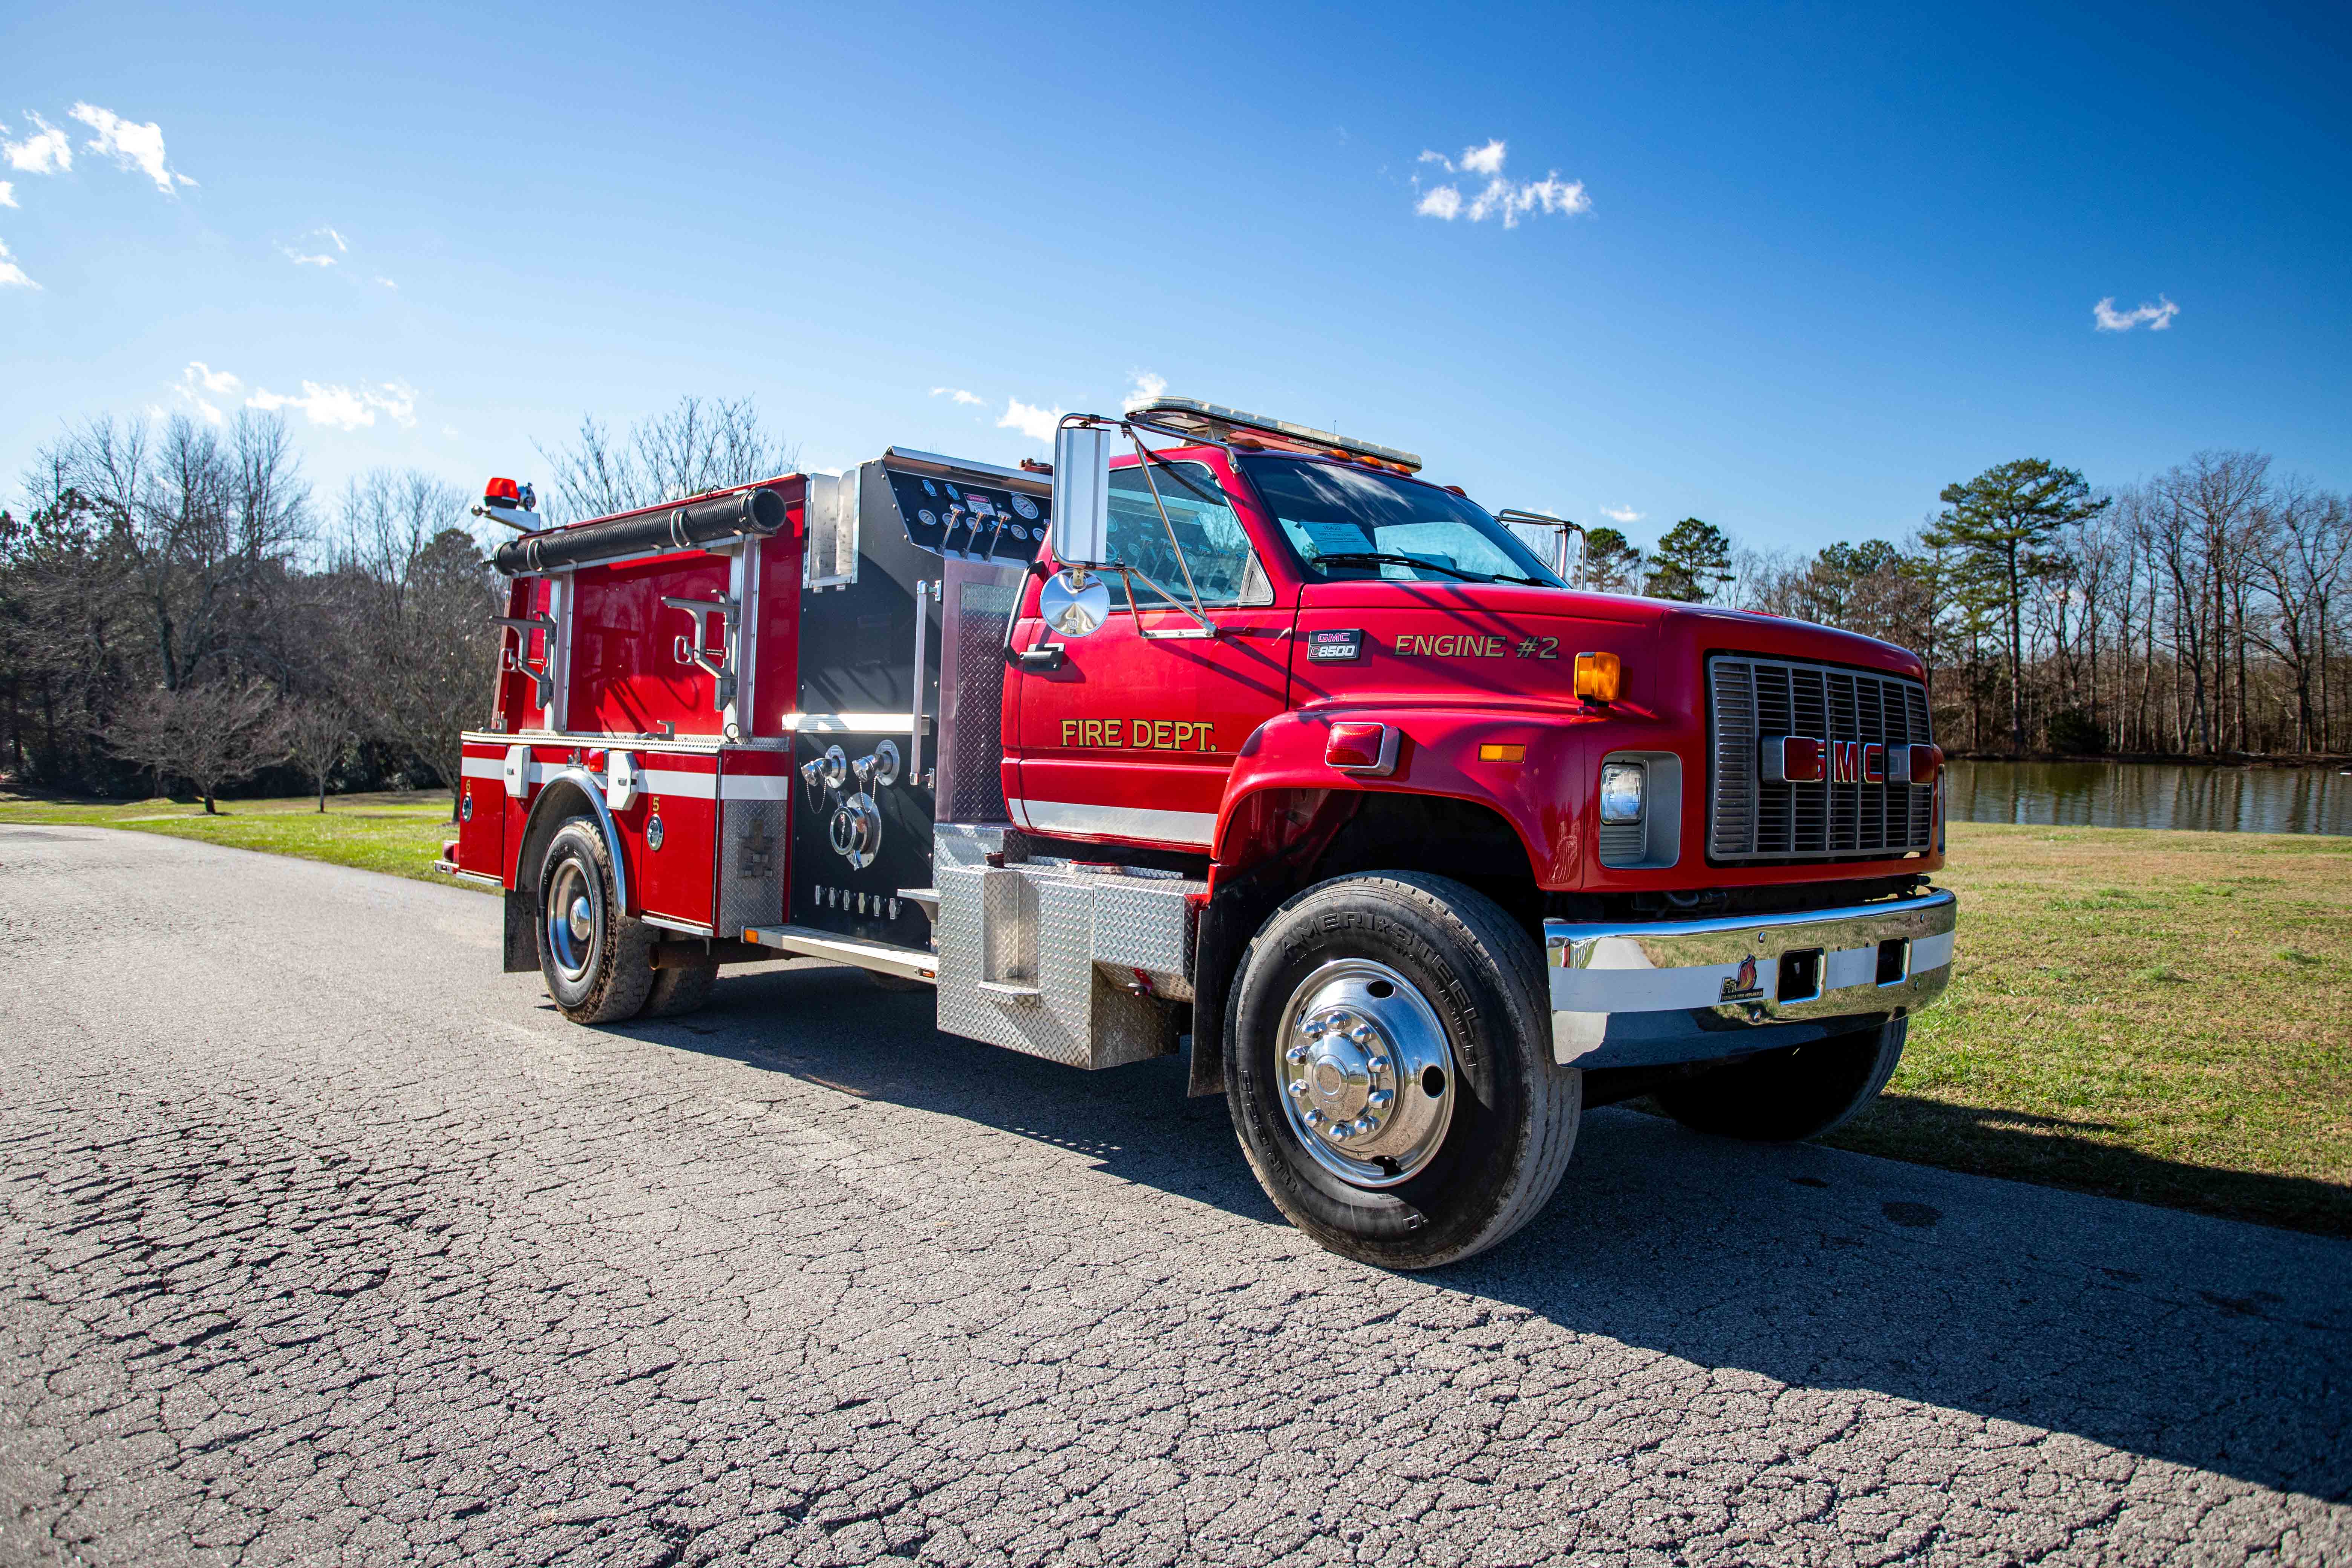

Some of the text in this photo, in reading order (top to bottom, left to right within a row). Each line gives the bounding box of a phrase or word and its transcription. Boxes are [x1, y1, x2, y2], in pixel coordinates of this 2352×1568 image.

[1318, 633, 1350, 642] GMC
[1310, 645, 1355, 657] C8500
[1394, 635, 1559, 659] ENGINE #2
[1060, 719, 1217, 752] FIRE DEPT.
[466, 779, 470, 792] 6
[652, 796, 660, 812] 5
